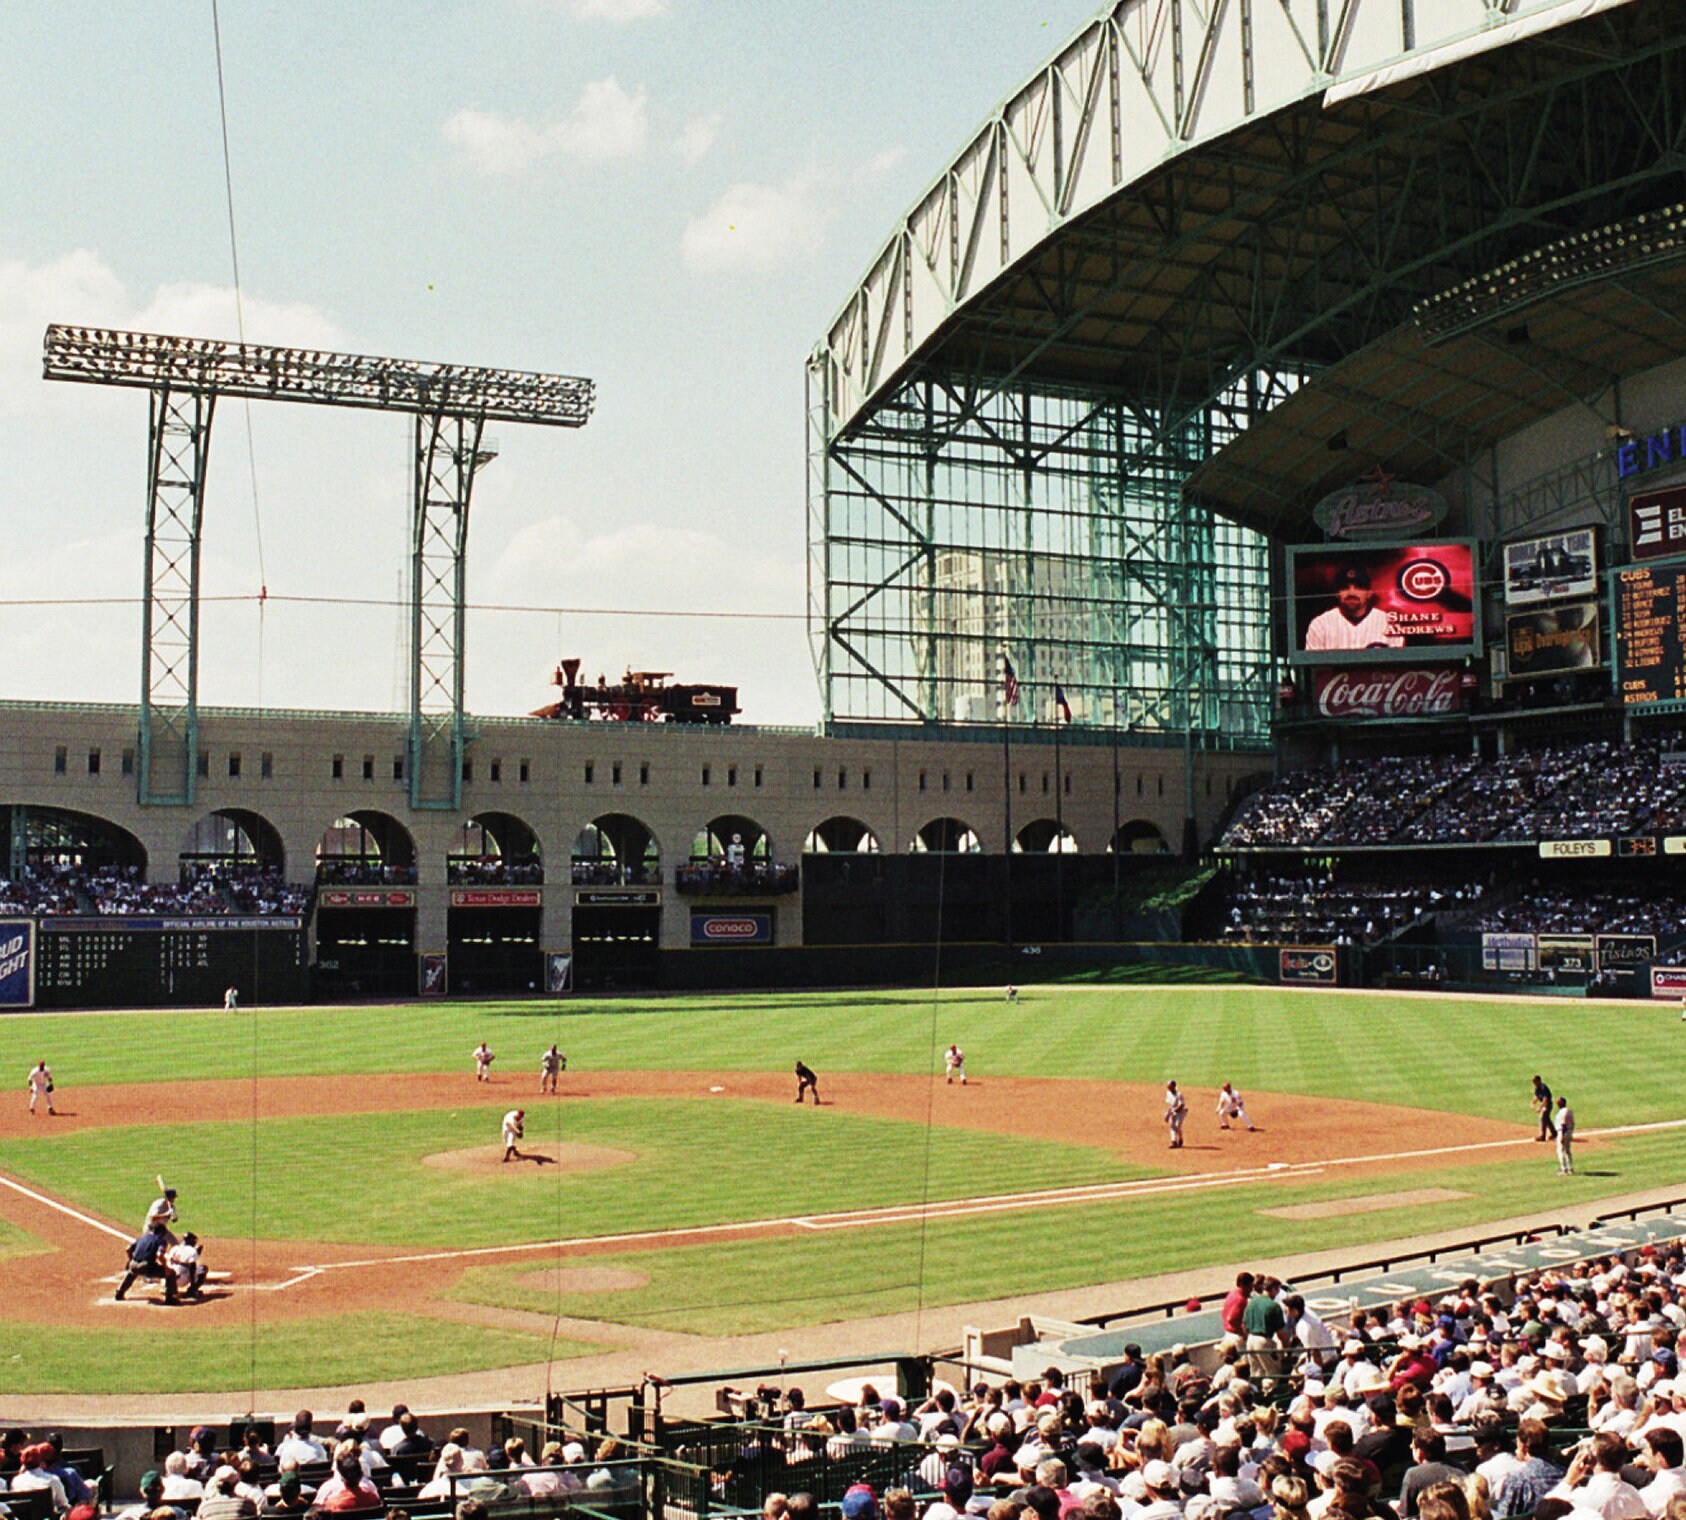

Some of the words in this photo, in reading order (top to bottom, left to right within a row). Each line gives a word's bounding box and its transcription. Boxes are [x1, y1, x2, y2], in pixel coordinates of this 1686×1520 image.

[1402, 562, 1445, 599] CUBS
[1620, 568, 1651, 583] CUBS
[1387, 611, 1440, 622] SHANE
[1385, 624, 1454, 635] ANDREWS
[1623, 680, 1646, 690] CUBS
[1318, 671, 1458, 716] Coca-Cola
[1624, 691, 1657, 703] ASTROS
[1552, 842, 1596, 855] FOLEY'S
[0, 936, 23, 959] UD
[1563, 957, 1582, 968] 373
